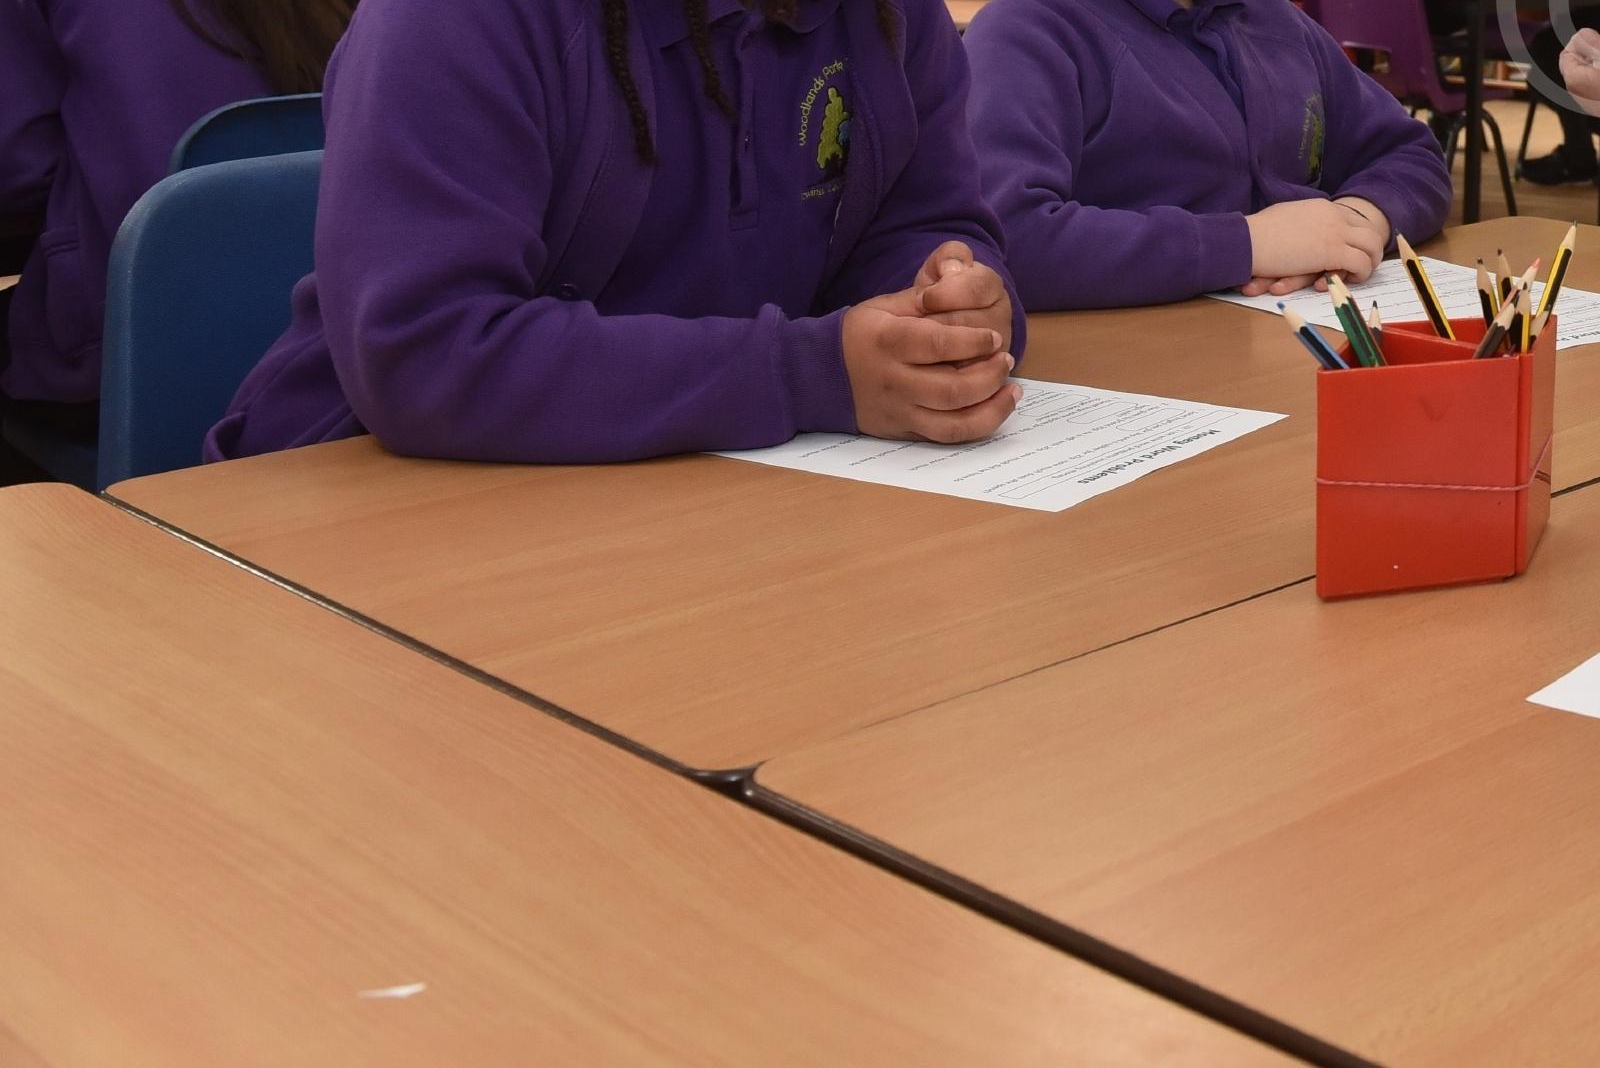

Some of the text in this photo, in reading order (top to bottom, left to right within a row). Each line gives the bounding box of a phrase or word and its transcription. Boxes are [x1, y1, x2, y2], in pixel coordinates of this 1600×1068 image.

[799, 76, 825, 147] Woodlands
[1077, 429, 1222, 484] Money Word Problems
